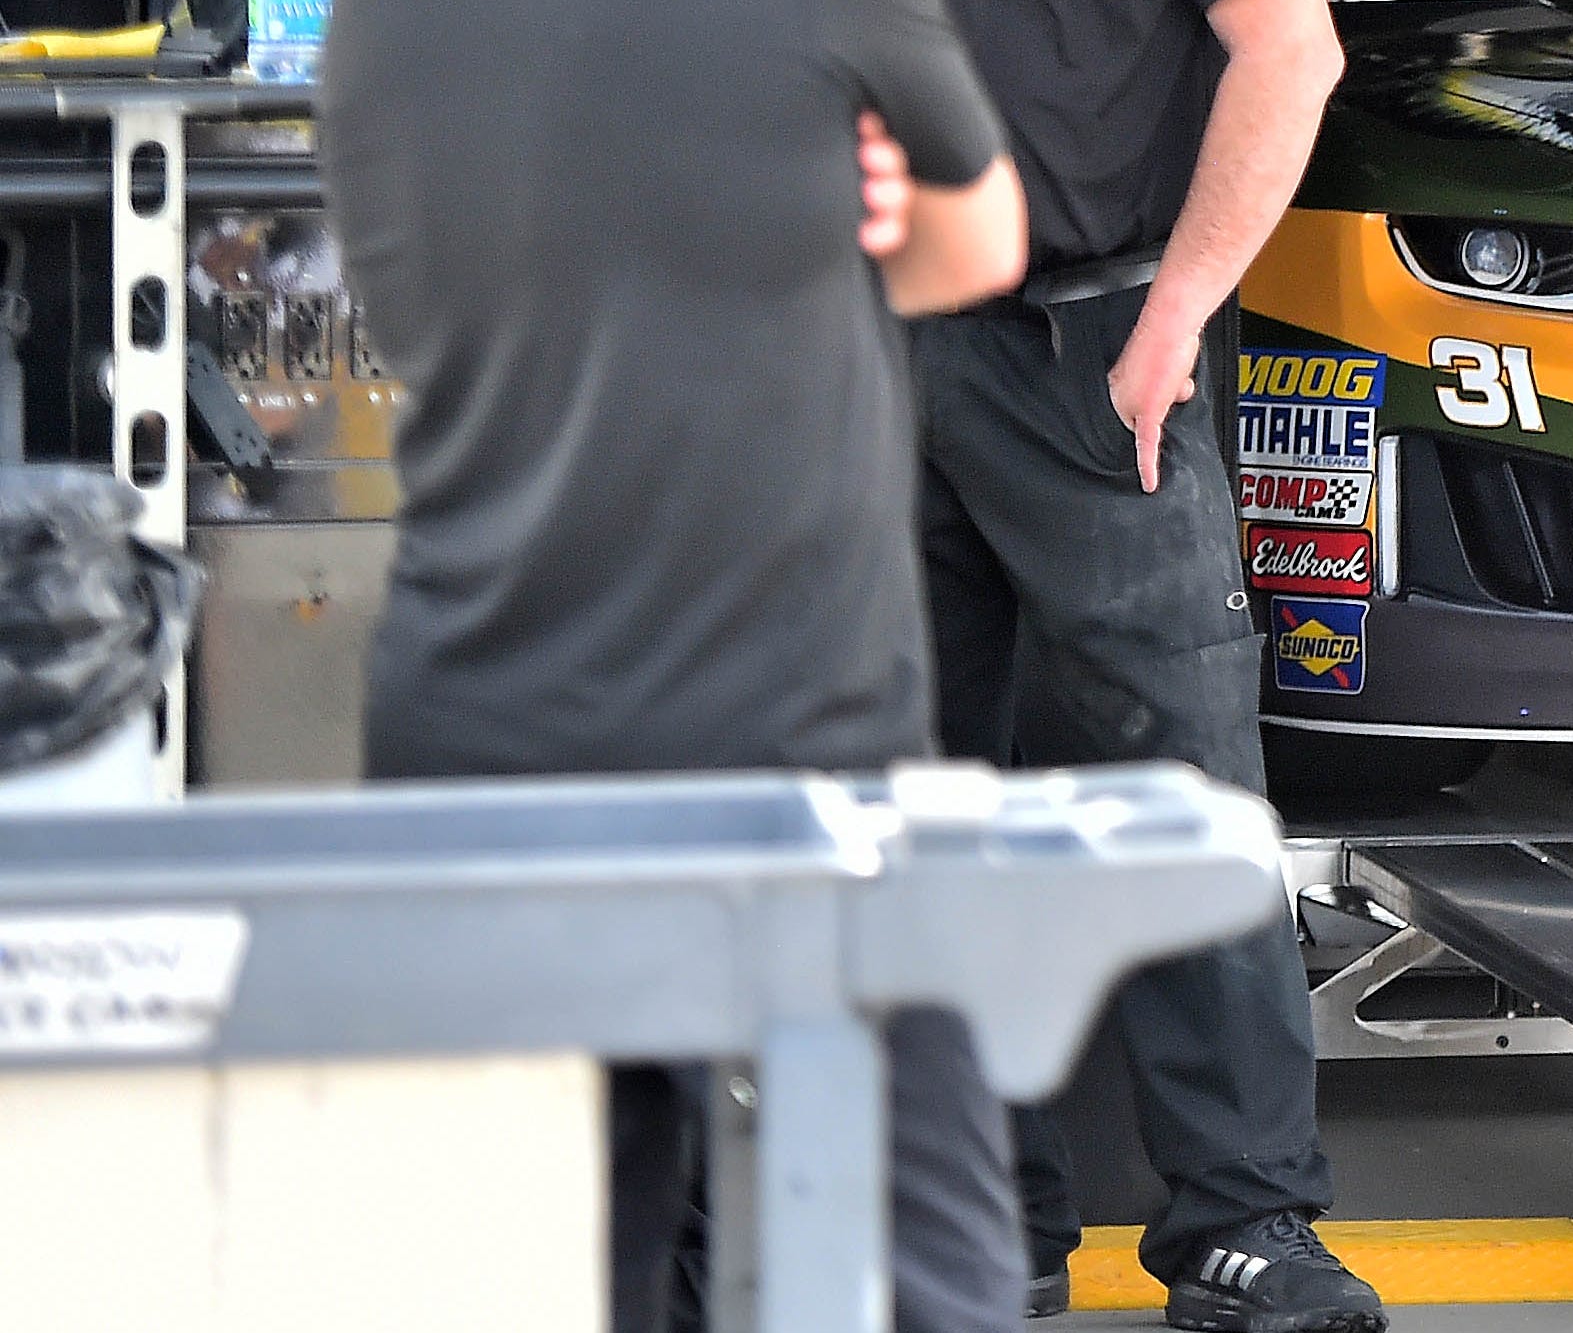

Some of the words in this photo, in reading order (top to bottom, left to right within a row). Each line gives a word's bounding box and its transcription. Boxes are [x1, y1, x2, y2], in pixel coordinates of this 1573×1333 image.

[1238, 354, 1379, 401] MOOG
[1428, 335, 1548, 435] 31
[1238, 405, 1370, 457] MAHLE
[1239, 473, 1328, 510] COMP
[1293, 505, 1348, 519] CAMS
[1252, 537, 1368, 582] Edelbrock
[1280, 635, 1356, 660] SUNOCO
